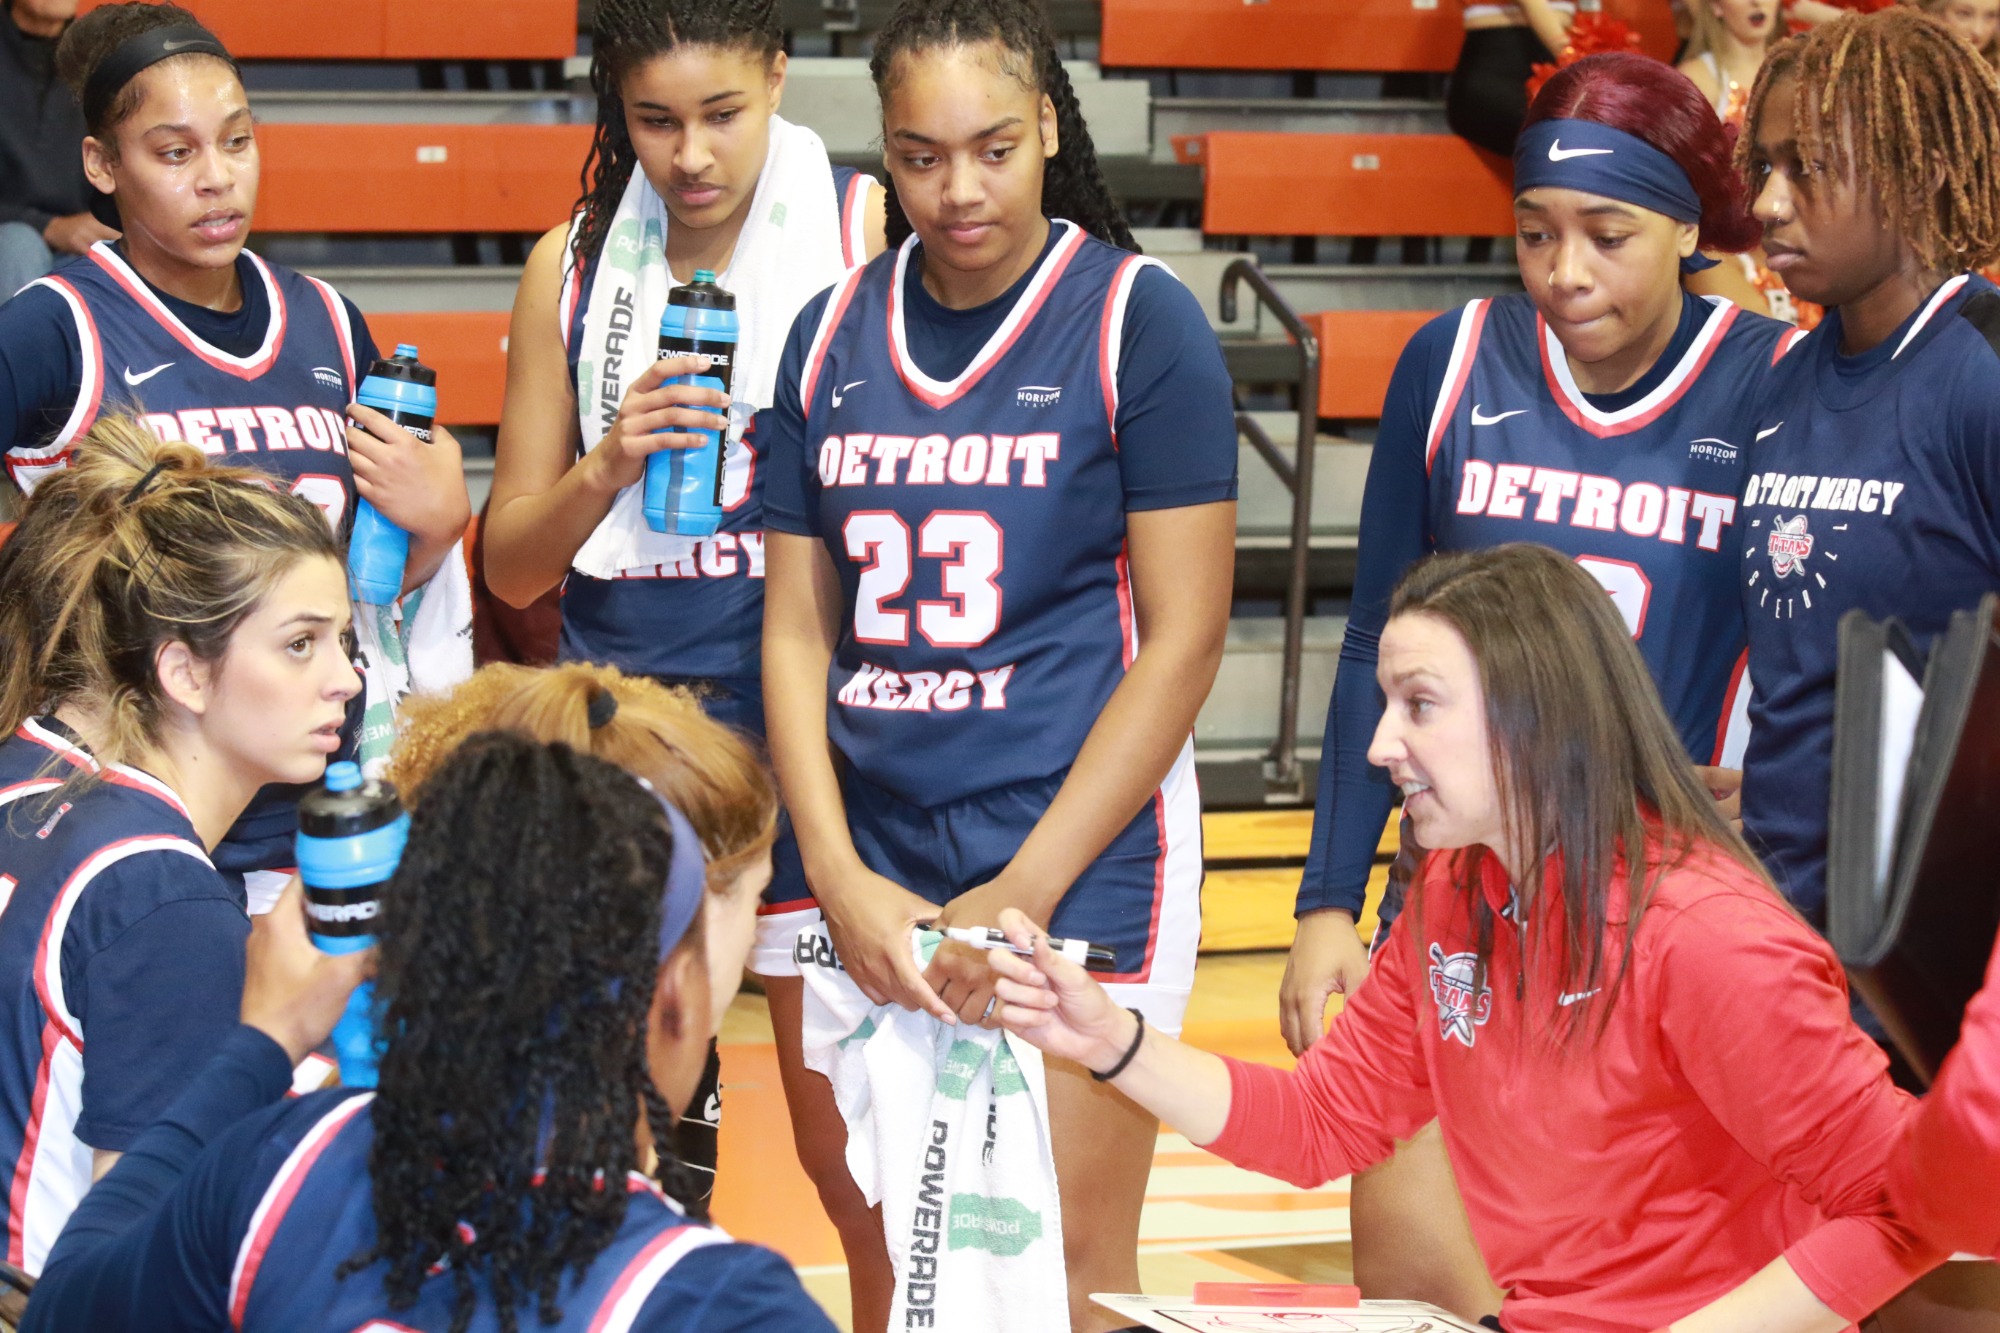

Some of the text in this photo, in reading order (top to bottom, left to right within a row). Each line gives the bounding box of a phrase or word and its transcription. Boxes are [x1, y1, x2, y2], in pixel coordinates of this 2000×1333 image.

[1017, 390, 1060, 403] HORIZON
[818, 432, 1060, 488] DETROIT
[1690, 444, 1737, 459] HORIZON
[1456, 459, 1738, 552] DETROIT
[1810, 476, 1904, 515] MERCY
[1769, 533, 1811, 556] TITANS
[841, 509, 1004, 648] 23
[837, 661, 1016, 712] MERCY
